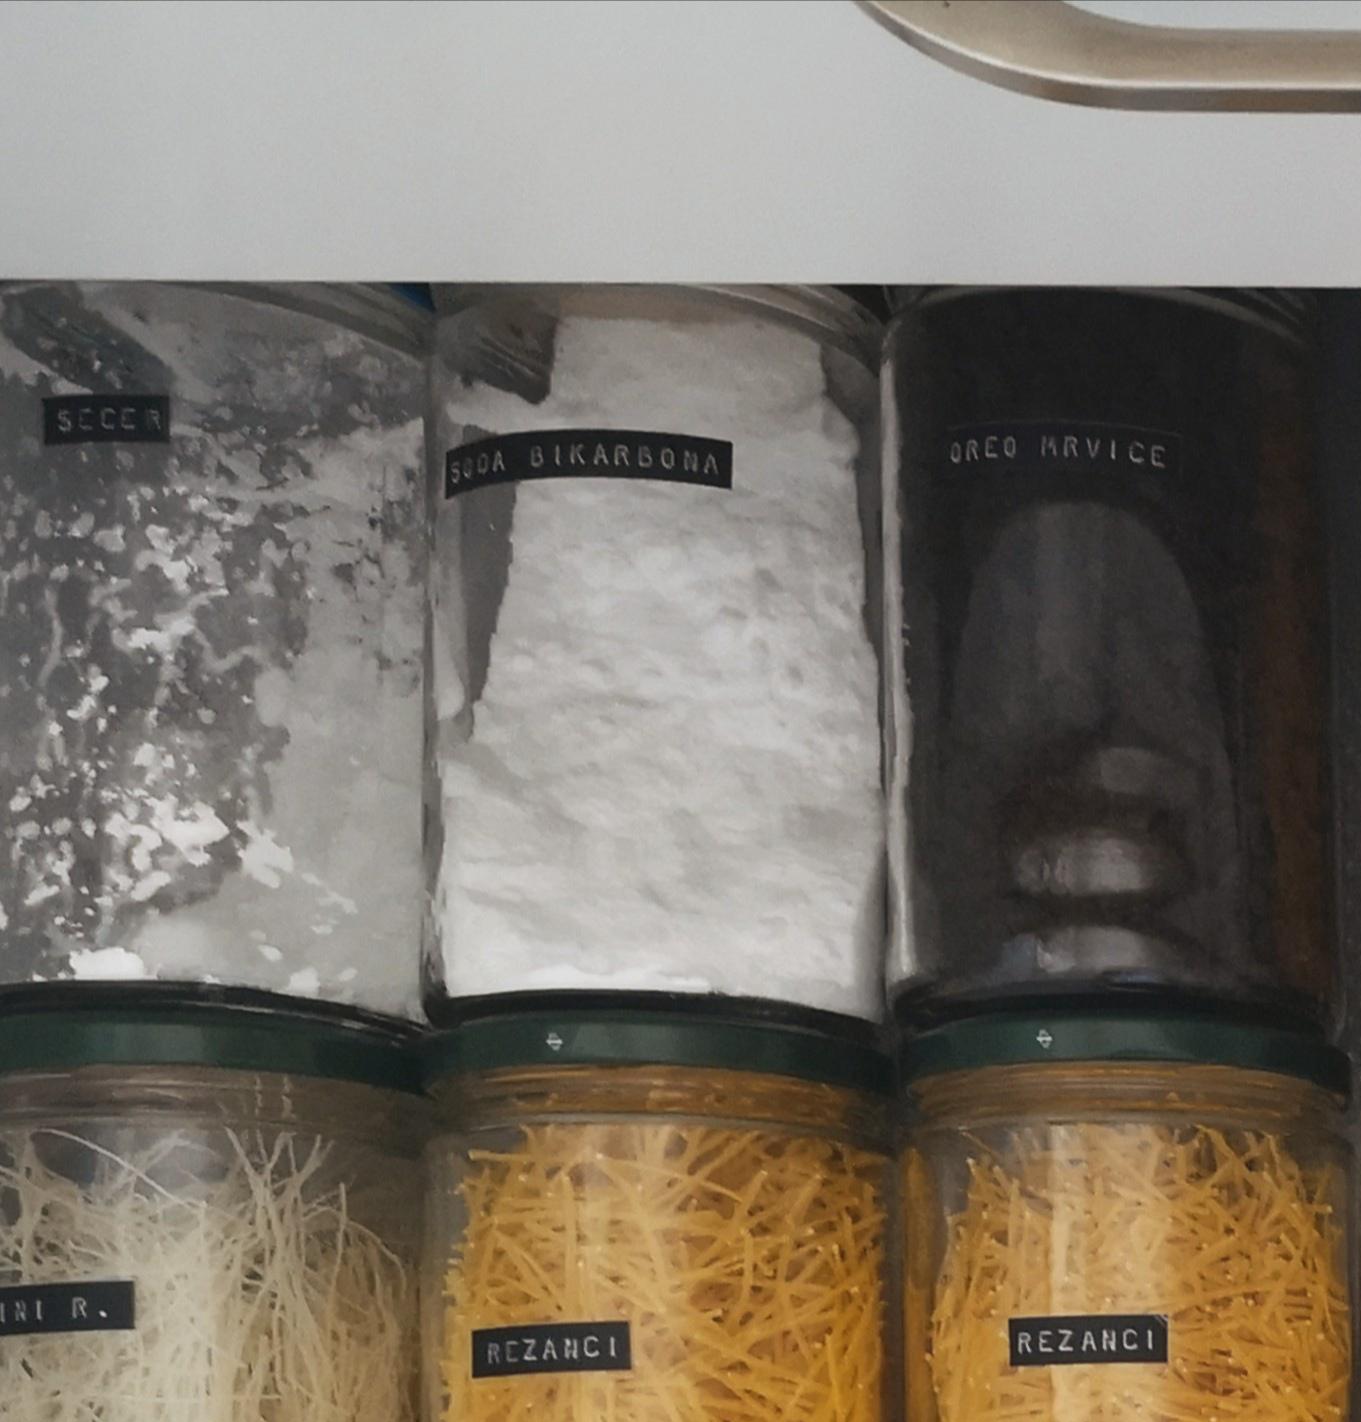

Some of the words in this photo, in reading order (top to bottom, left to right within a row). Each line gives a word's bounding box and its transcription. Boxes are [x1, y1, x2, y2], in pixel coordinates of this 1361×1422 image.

[449, 449, 506, 478] SODA
[529, 441, 720, 476] BIKARBONA
[949, 436, 1018, 464] OREO
[1040, 437, 1167, 468] MRVICE
[71, 1296, 109, 1320] R.
[486, 1335, 618, 1365] REZANCI
[1017, 1328, 1154, 1355] REZANCI
